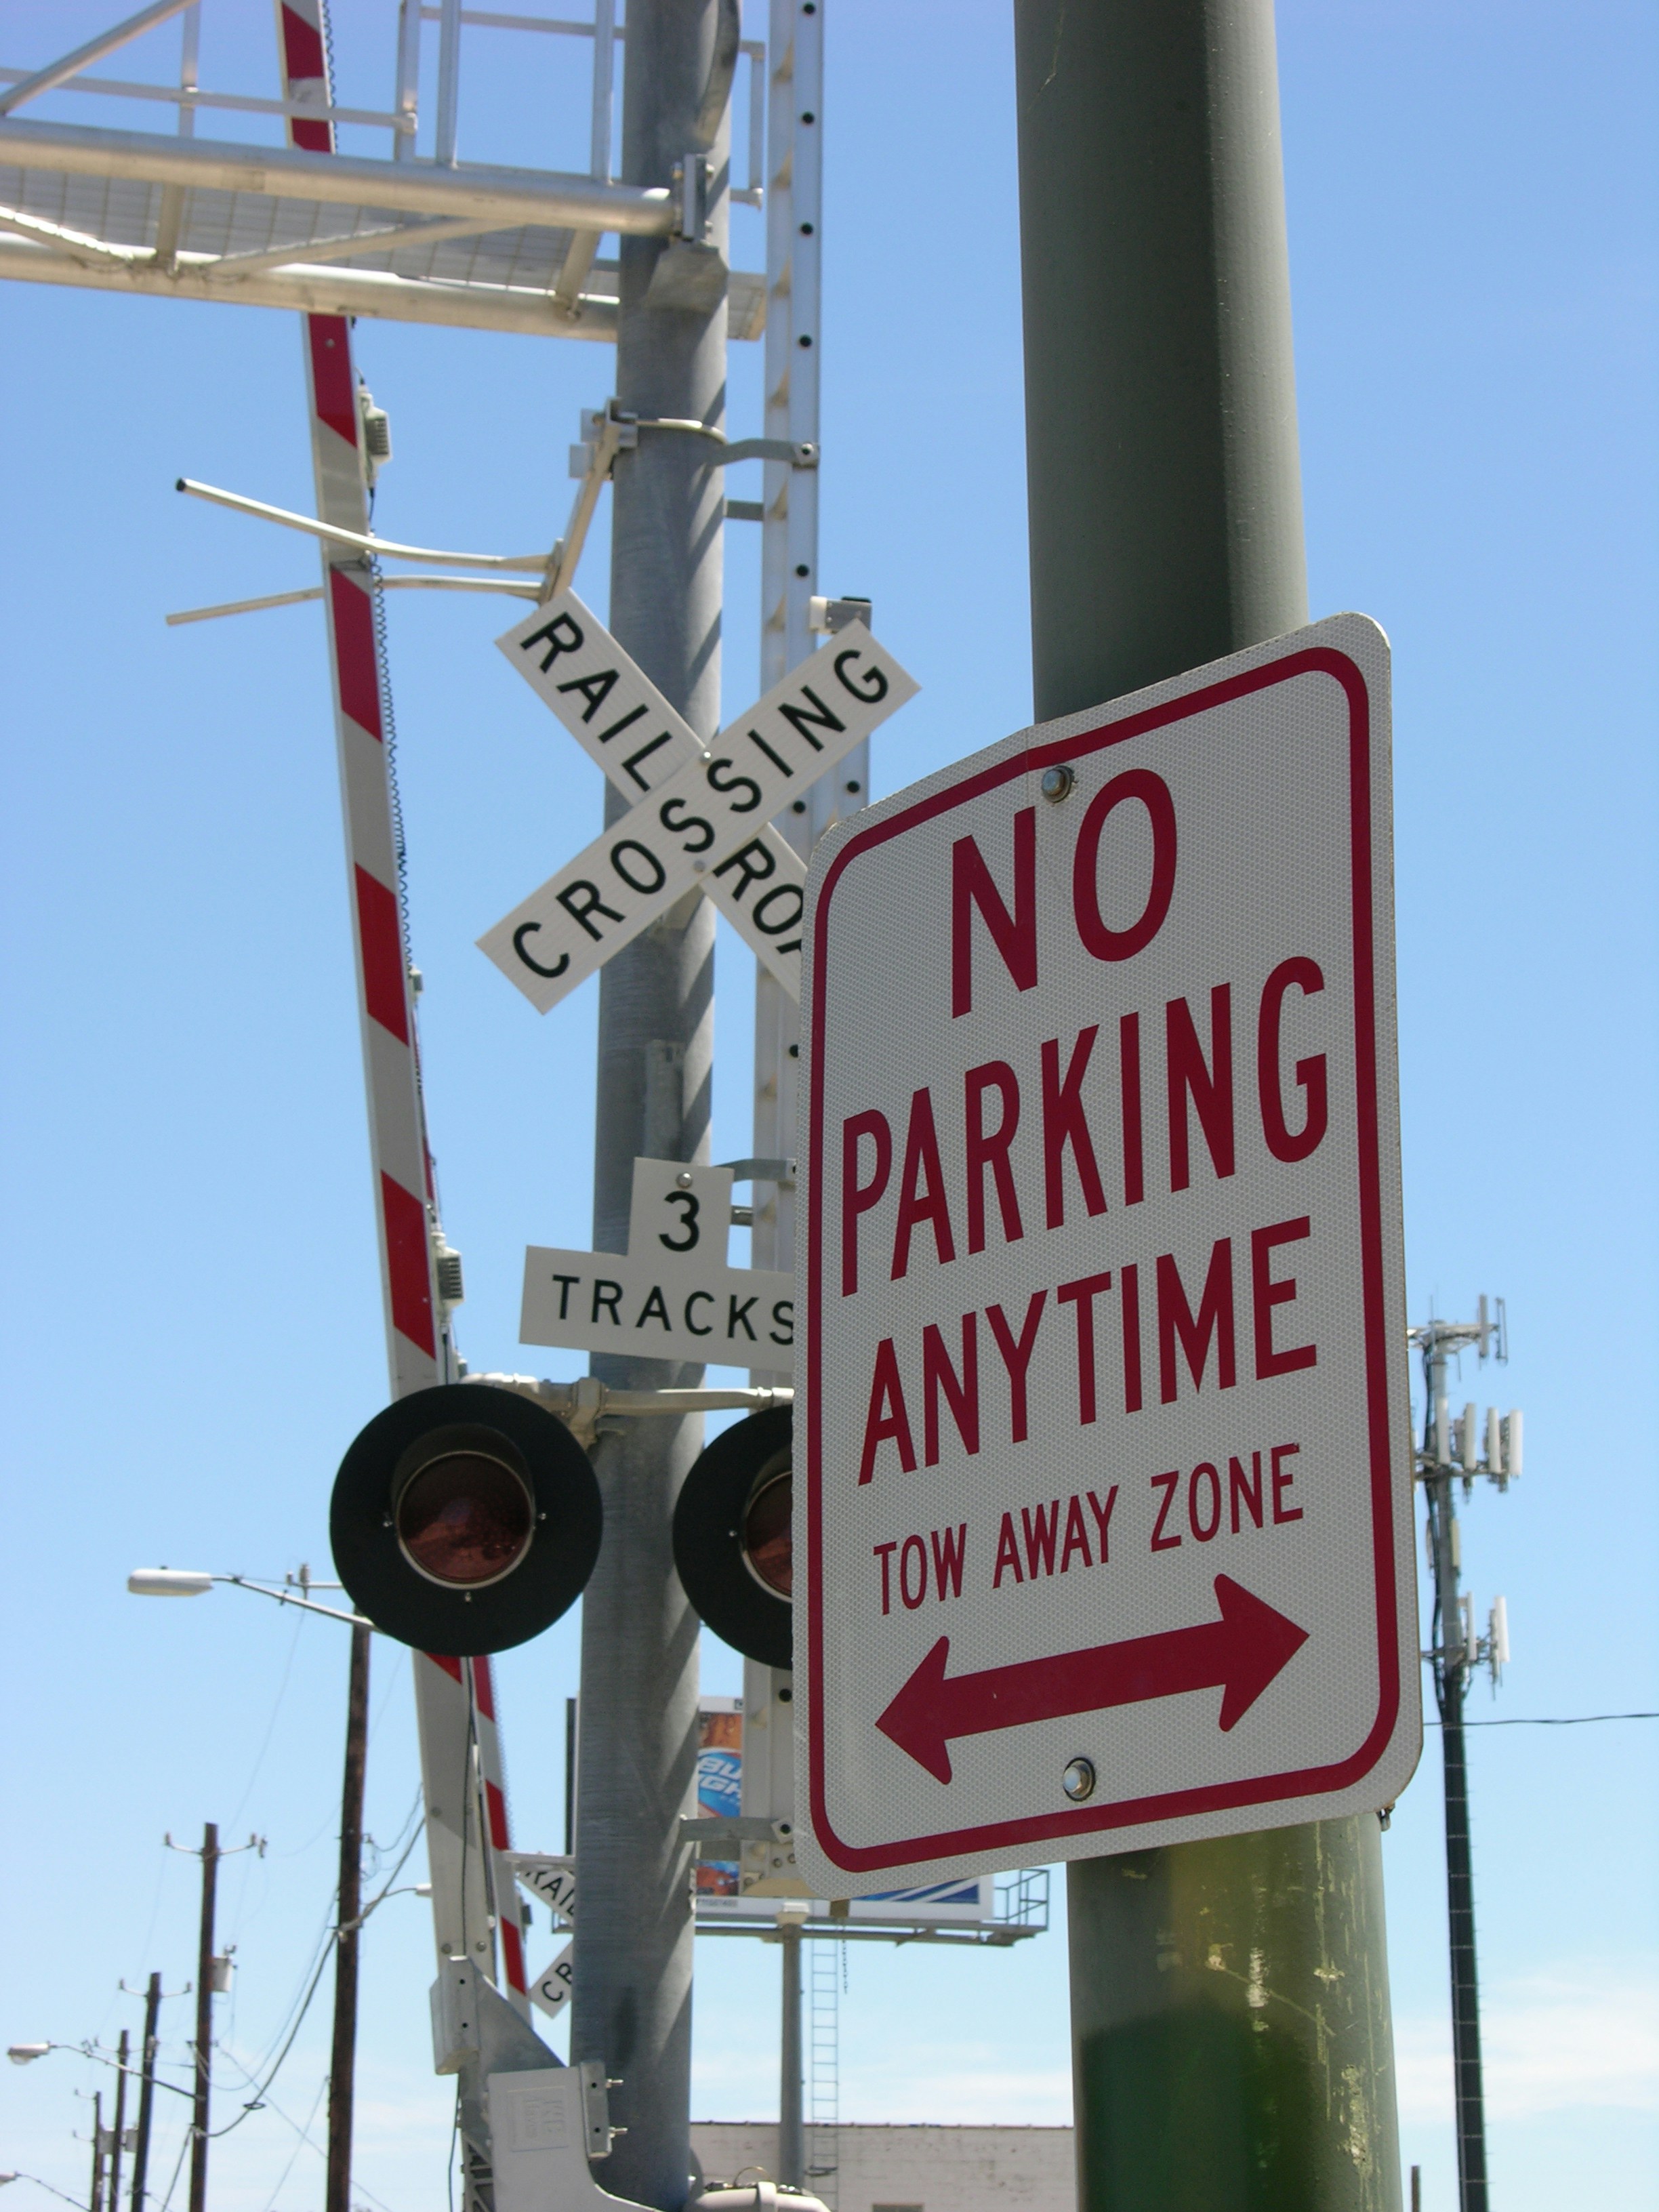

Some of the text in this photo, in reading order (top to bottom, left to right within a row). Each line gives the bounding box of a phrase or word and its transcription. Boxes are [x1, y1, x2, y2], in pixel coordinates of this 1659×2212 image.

[512, 649, 889, 979] CROSSING
[520, 611, 804, 954] RAIL RO
[951, 769, 1177, 1019] NO
[658, 1190, 700, 1252] 3
[842, 956, 1328, 1297] PARKING
[552, 1274, 794, 1345] TRACKS
[859, 1216, 1317, 1486] ANYTIME
[873, 1443, 1304, 1616] TOW AWAY ZONE
